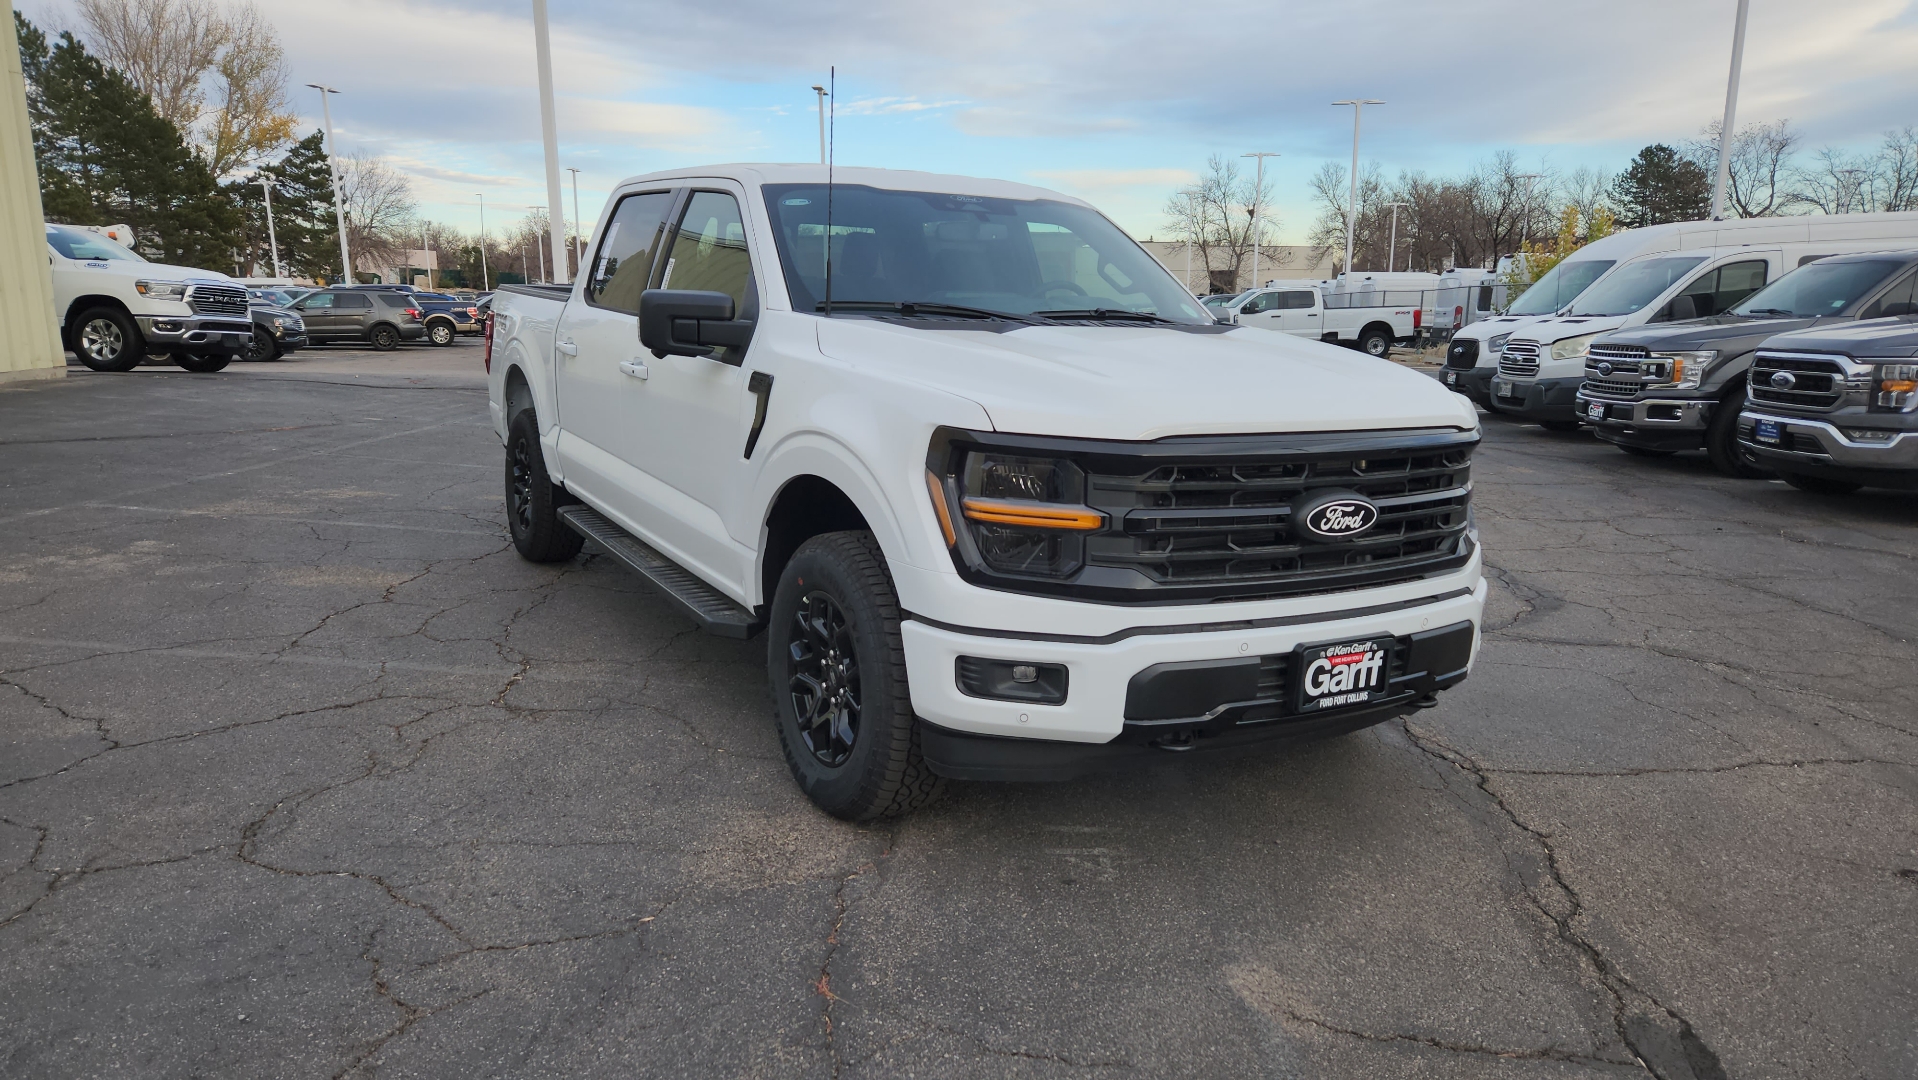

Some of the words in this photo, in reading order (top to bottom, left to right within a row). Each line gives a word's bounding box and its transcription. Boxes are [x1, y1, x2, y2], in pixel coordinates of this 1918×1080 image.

[1320, 505, 1365, 531] Ford
[1304, 649, 1384, 697] Garff
[1319, 697, 1334, 708] FORD
[1333, 694, 1348, 706] FORT
[1347, 691, 1369, 704] COLLINS
